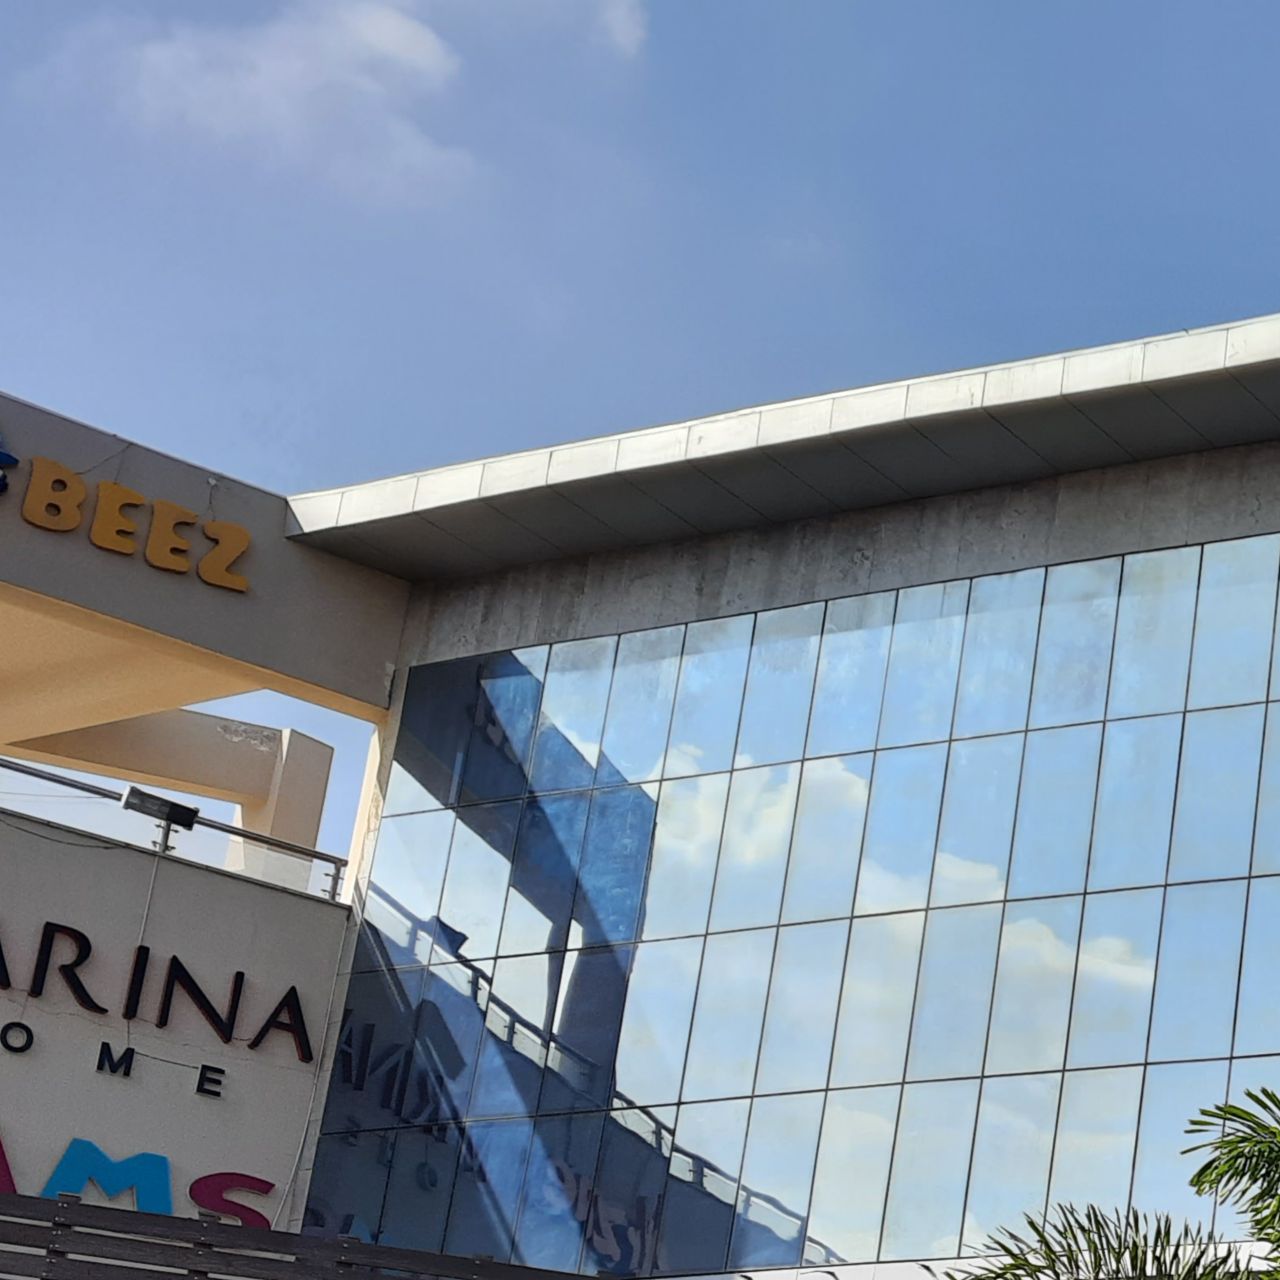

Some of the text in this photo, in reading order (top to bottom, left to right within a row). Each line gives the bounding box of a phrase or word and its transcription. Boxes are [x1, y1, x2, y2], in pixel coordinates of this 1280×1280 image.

[21, 455, 251, 592] BEEZ
[0, 921, 314, 1063] RINA
[0, 1130, 276, 1231] MS
